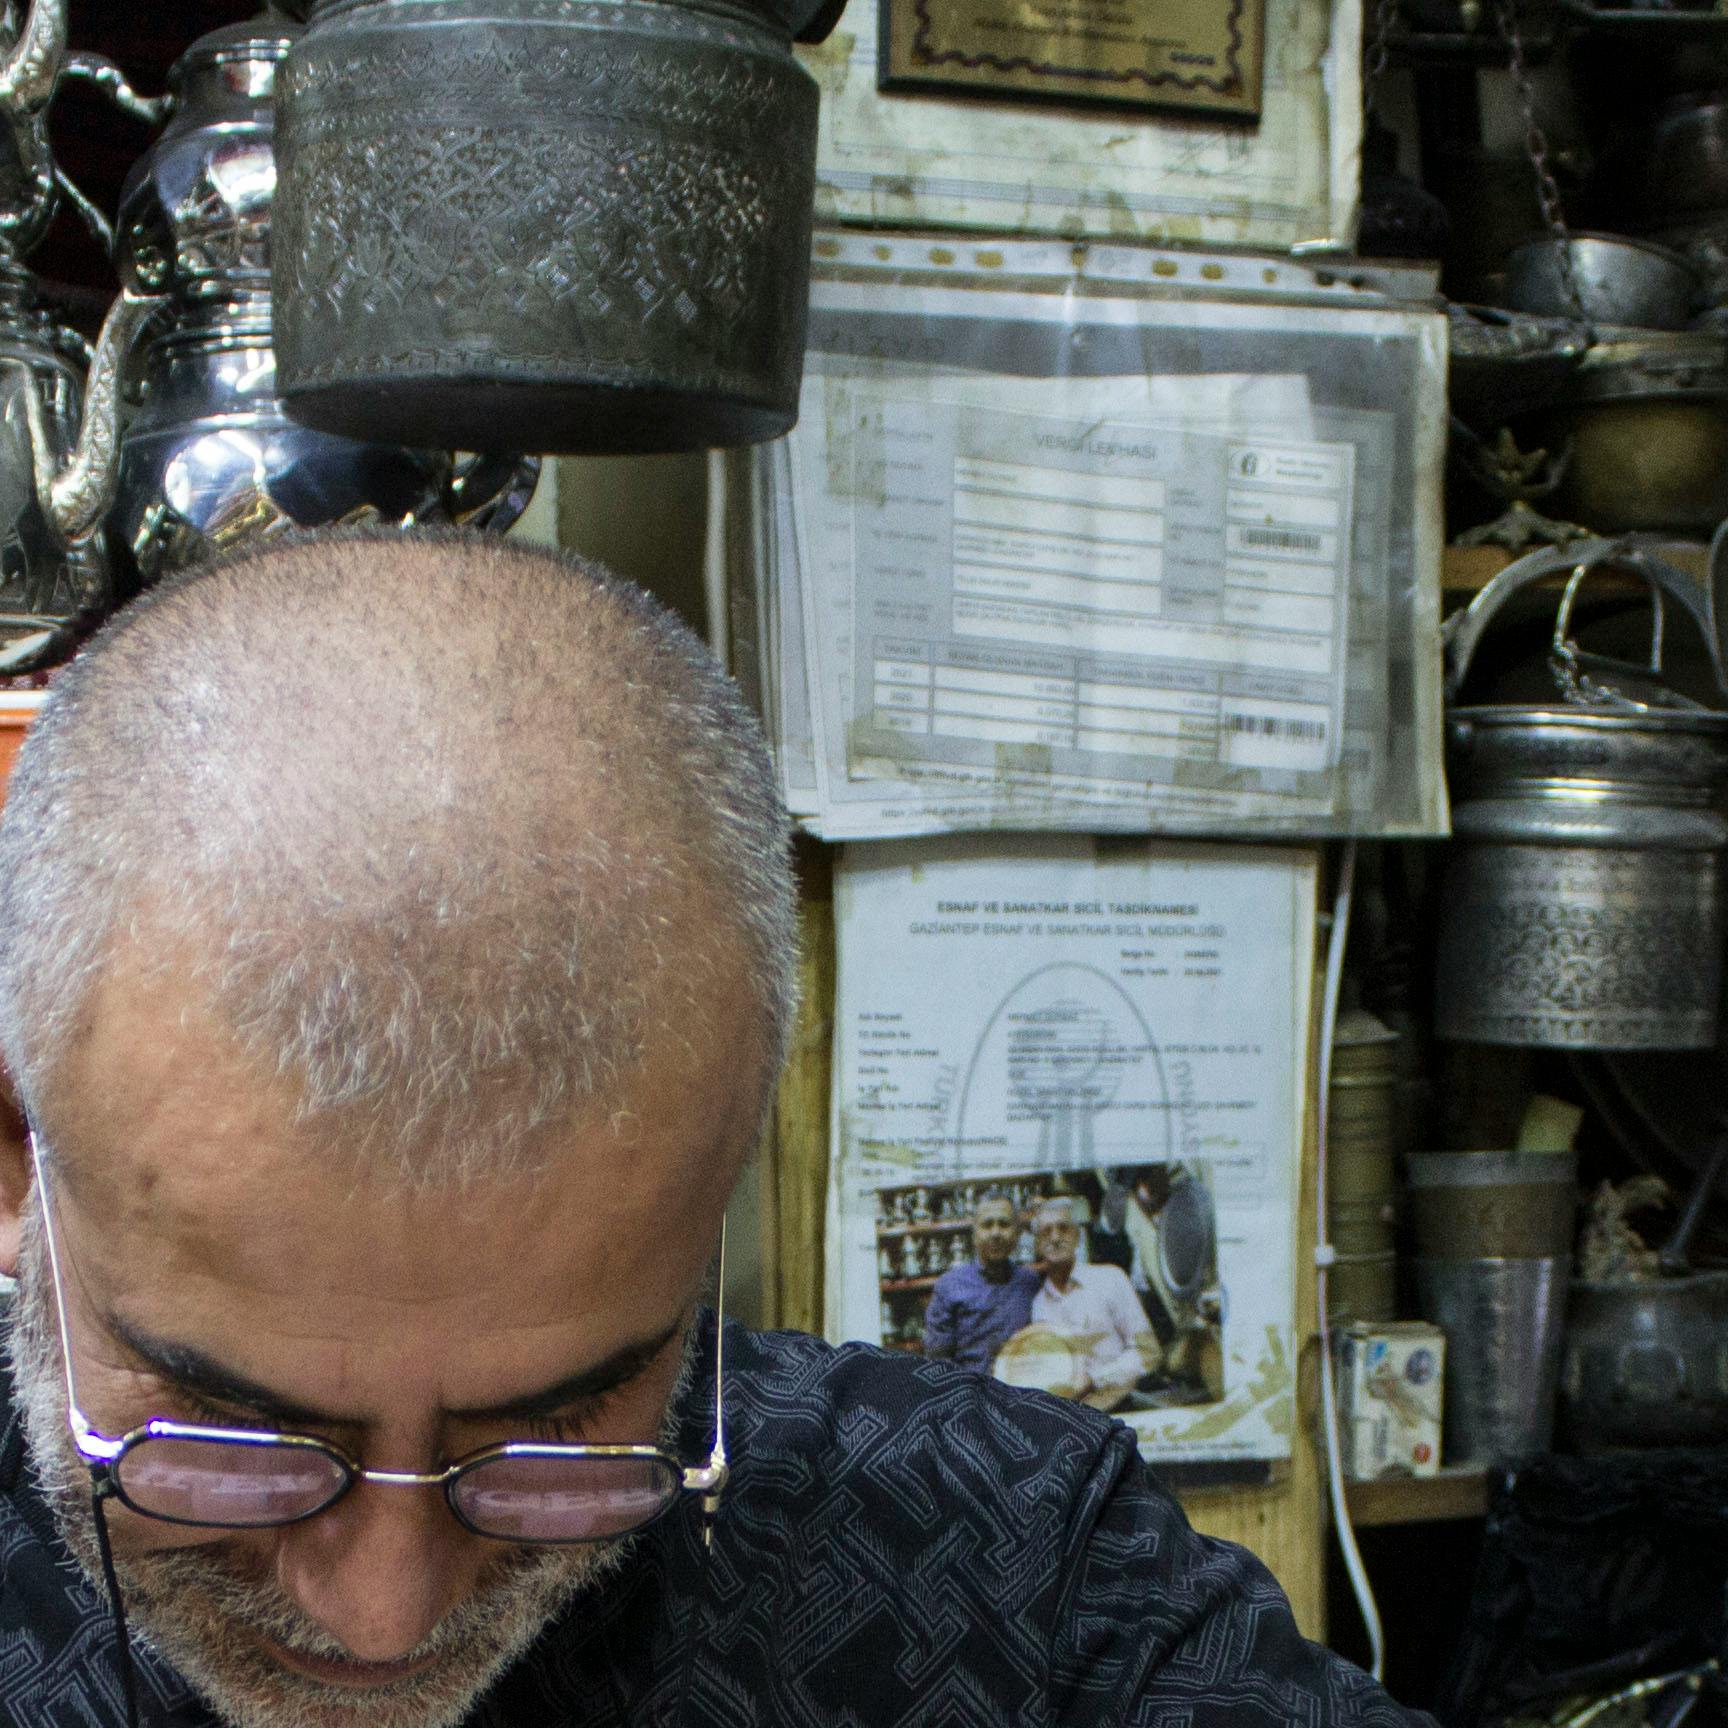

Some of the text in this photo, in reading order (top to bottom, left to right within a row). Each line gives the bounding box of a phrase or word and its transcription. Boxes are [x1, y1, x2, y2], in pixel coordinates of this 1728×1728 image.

[937, 900, 979, 914] ESNAF
[983, 900, 999, 914] VE
[909, 921, 979, 937] GAZİANTEP
[982, 921, 1024, 937] ESNAF
[1028, 922, 1043, 937] VE
